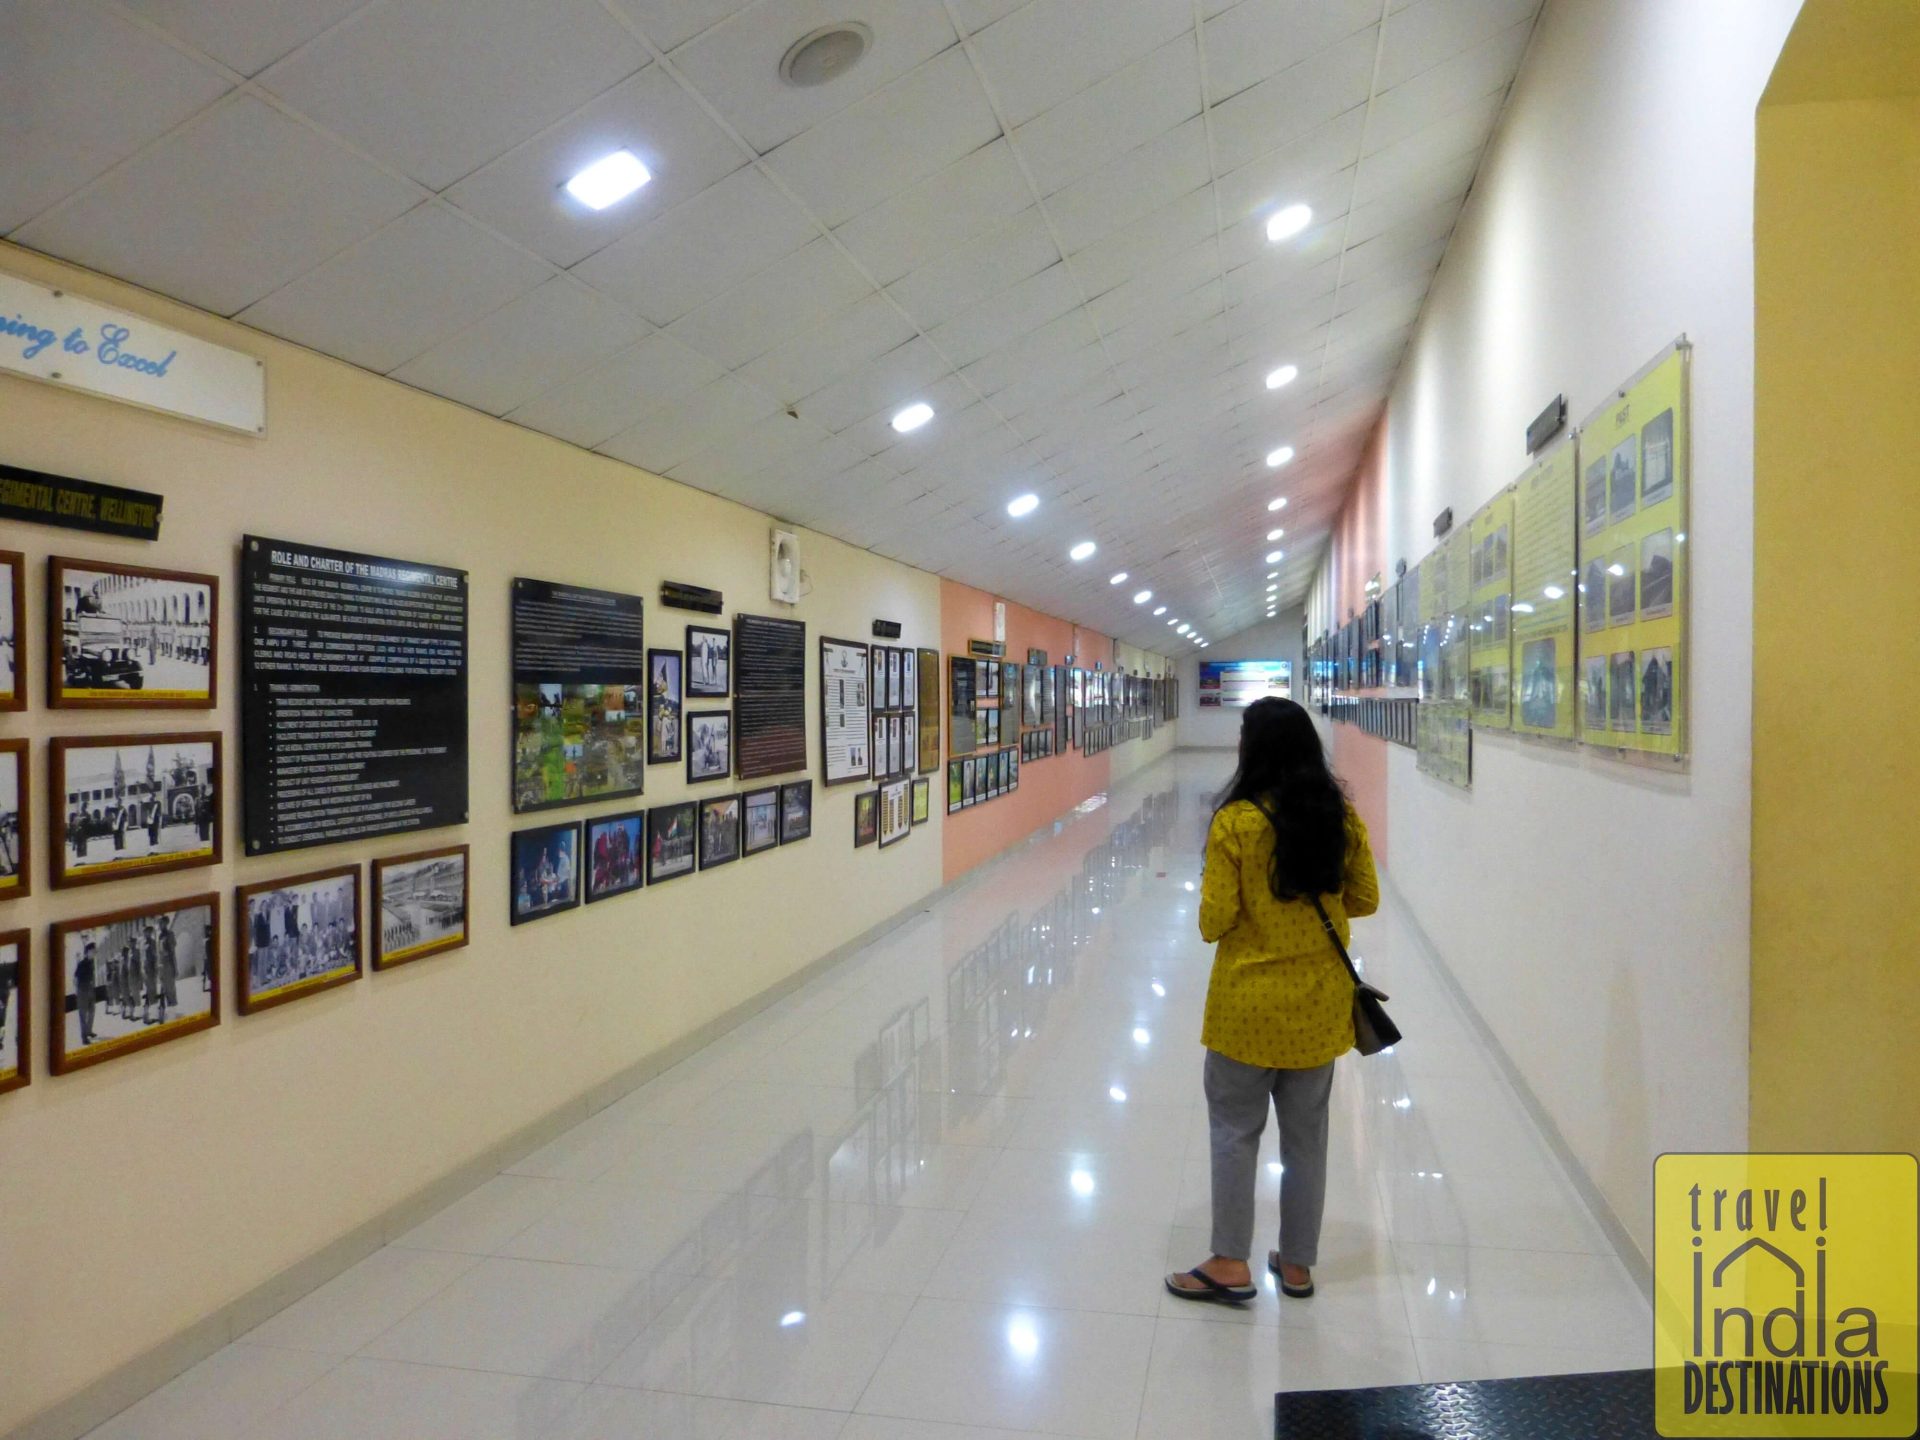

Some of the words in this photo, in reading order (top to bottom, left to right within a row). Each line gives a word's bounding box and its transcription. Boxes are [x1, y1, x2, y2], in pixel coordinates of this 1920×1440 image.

[63, 327, 90, 354] to
[271, 550, 292, 565] ROLE
[293, 553, 309, 567] AND
[310, 556, 344, 572] CHARTER
[345, 560, 354, 574] OF
[355, 563, 369, 576] THE
[435, 575, 458, 589] CENTRE
